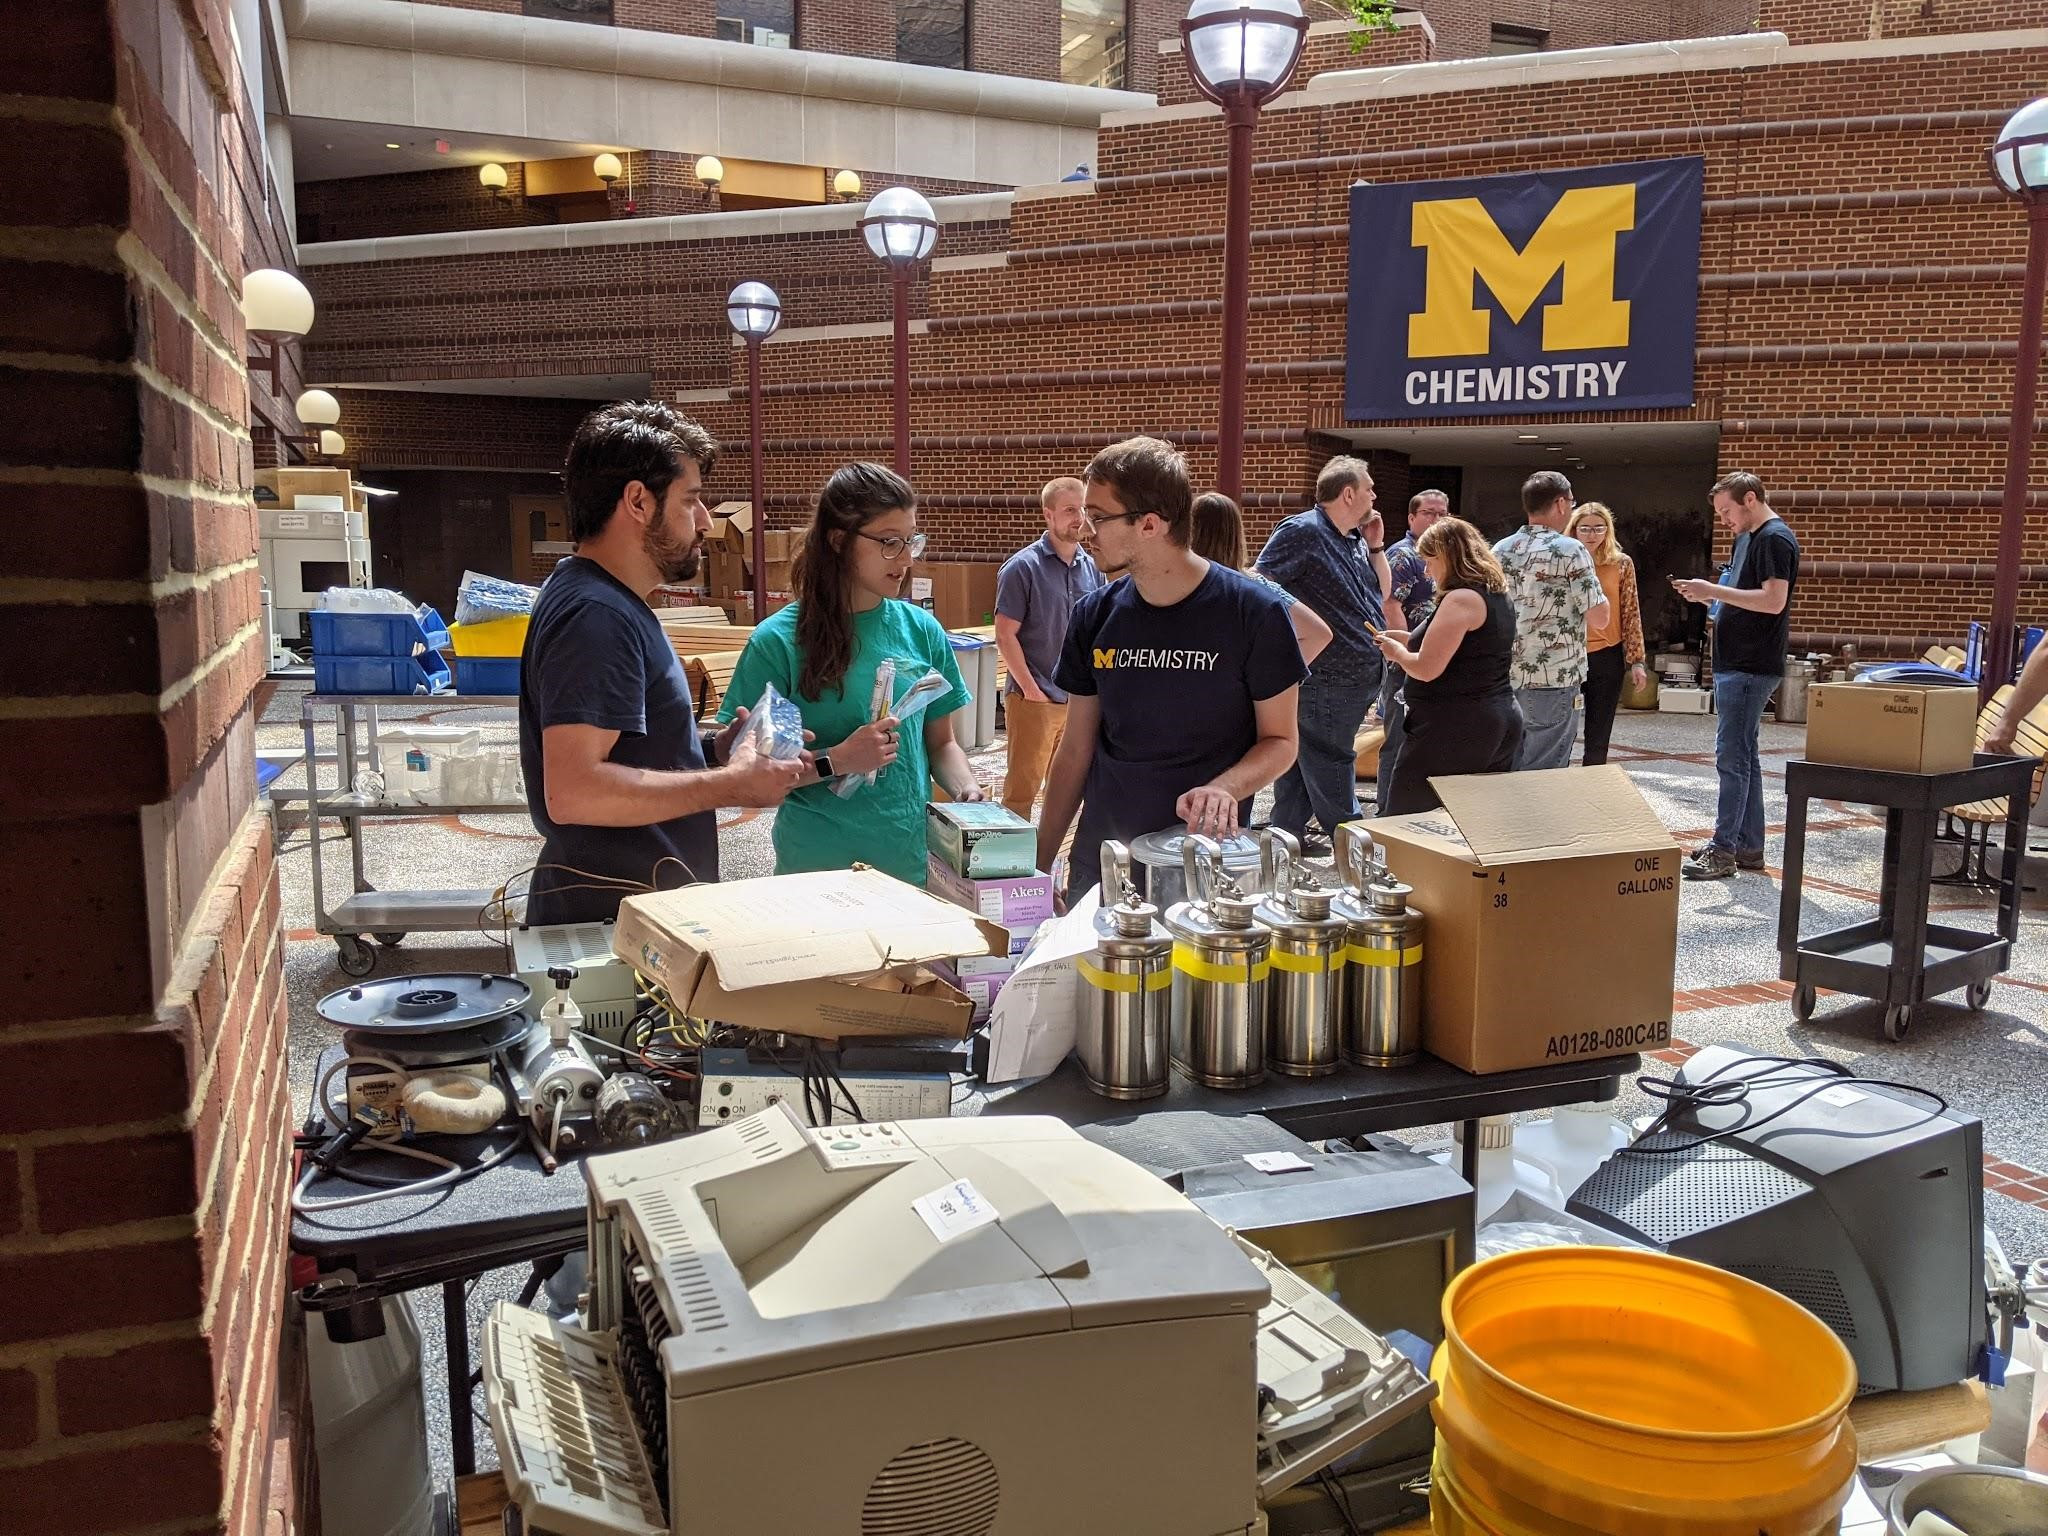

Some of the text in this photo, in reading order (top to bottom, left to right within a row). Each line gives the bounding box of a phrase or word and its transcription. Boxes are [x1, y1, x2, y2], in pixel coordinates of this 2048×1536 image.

[1407, 182, 1637, 358] M
[1405, 360, 1627, 406] CHEMISTRY
[1092, 648, 1219, 671] M CHEMISTRY
[1893, 695, 1909, 704] ONE
[1883, 704, 1919, 715] GALLONS
[1634, 856, 1660, 872] ONE
[1498, 871, 1506, 886] 4
[1617, 876, 1674, 896] GALLONS
[1010, 886, 1046, 899] Akers
[1493, 893, 1508, 909] 38
[1546, 1021, 1668, 1059] A0128-080C4B
[732, 1105, 746, 1113] ON
